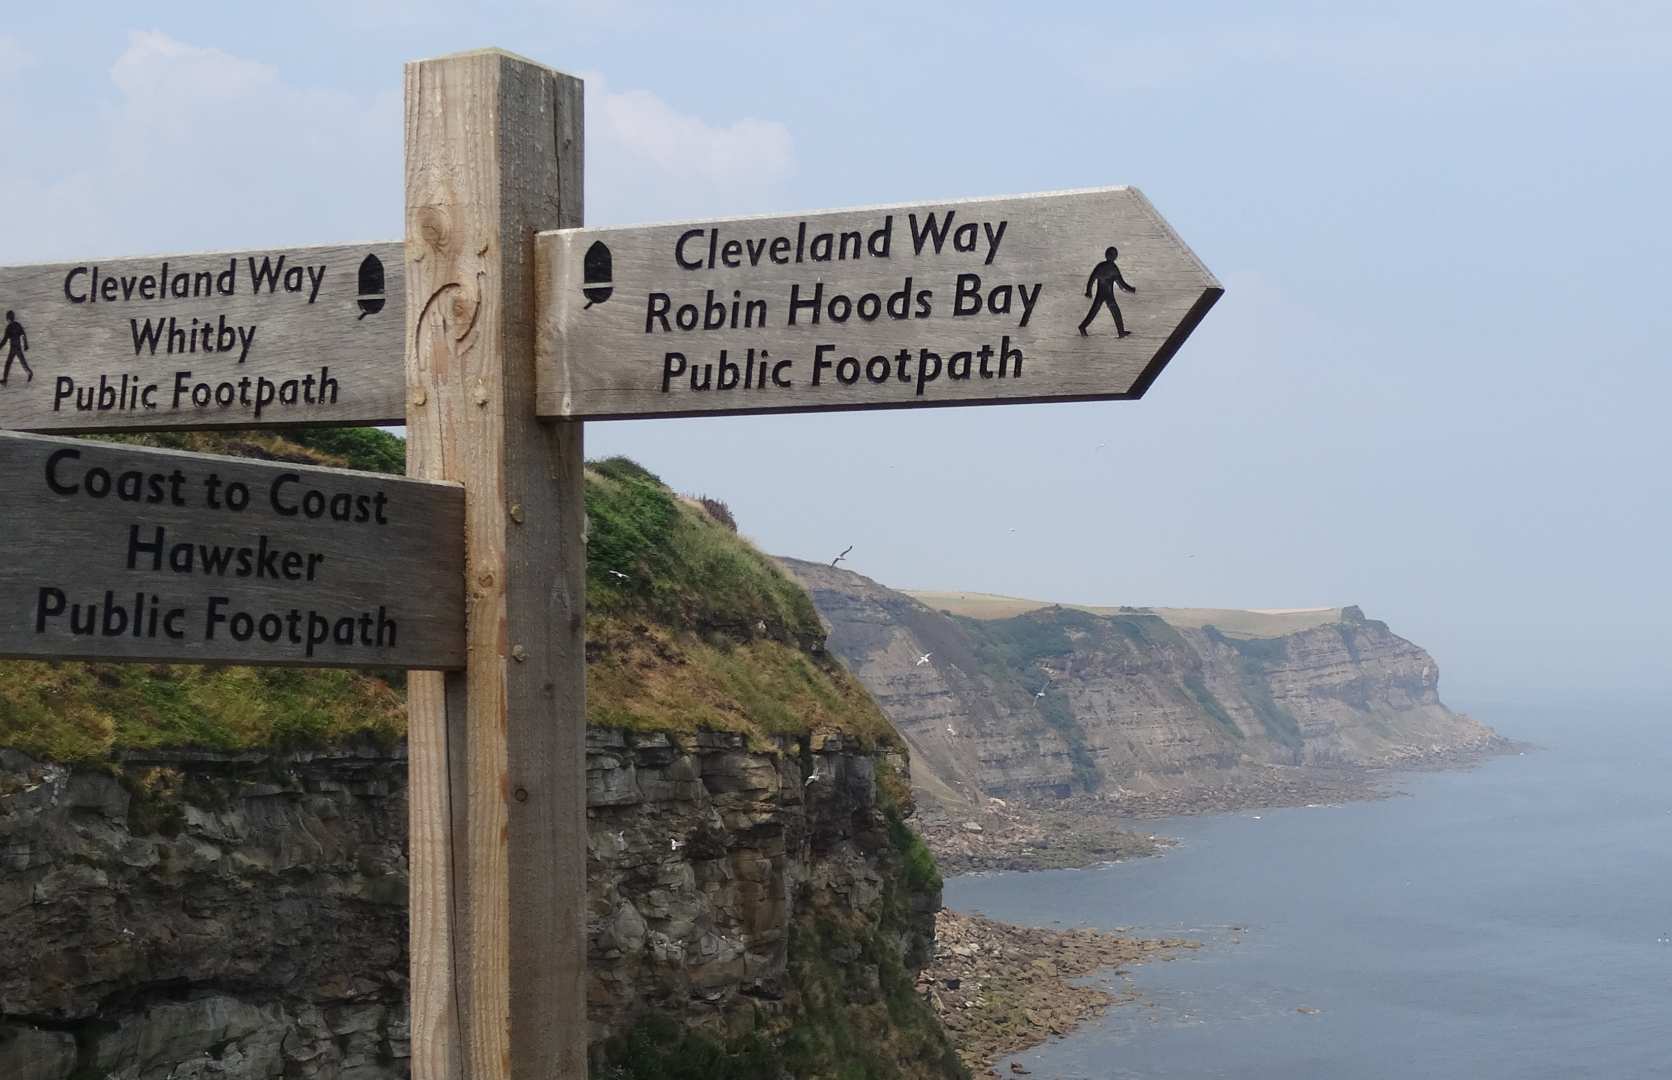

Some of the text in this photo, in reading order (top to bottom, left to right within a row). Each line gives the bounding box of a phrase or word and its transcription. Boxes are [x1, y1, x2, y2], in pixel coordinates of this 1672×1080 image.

[675, 210, 1008, 272] Cleveland Way
[63, 254, 327, 305] Cleveland Way
[645, 273, 1043, 334] Robin Hoods Bay
[129, 314, 257, 364] Whitby
[661, 335, 1023, 396] Public Footpath
[53, 365, 340, 419] Public Footpath
[45, 448, 389, 526] Coast to Coast
[126, 523, 325, 582] Hawsker
[35, 586, 398, 658] Public Footpath
